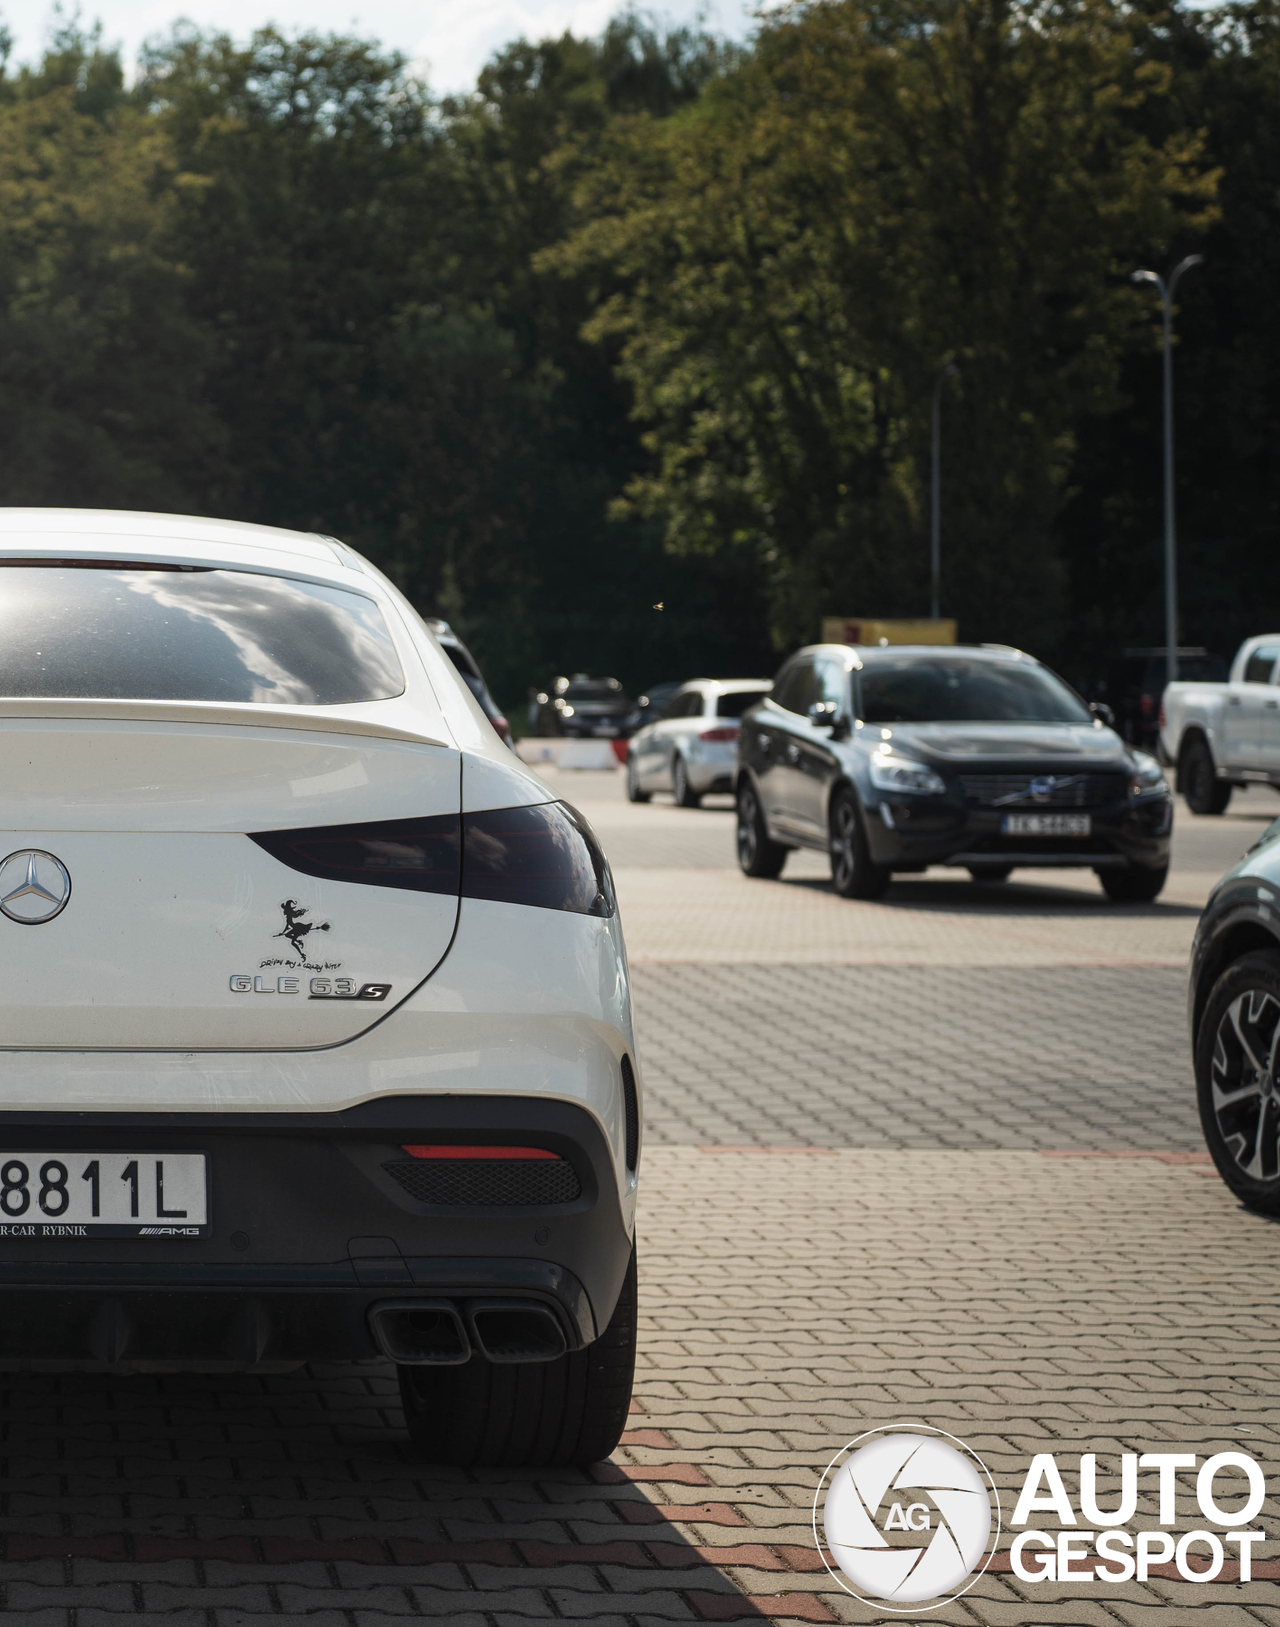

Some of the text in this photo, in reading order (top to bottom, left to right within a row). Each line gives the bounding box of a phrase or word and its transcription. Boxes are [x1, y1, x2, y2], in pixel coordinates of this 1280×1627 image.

[229, 974, 386, 998] GLE 63 S
[0, 1160, 188, 1218] 8811L
[41, 1225, 88, 1236] RYBNIK
[160, 1227, 200, 1235] AMG
